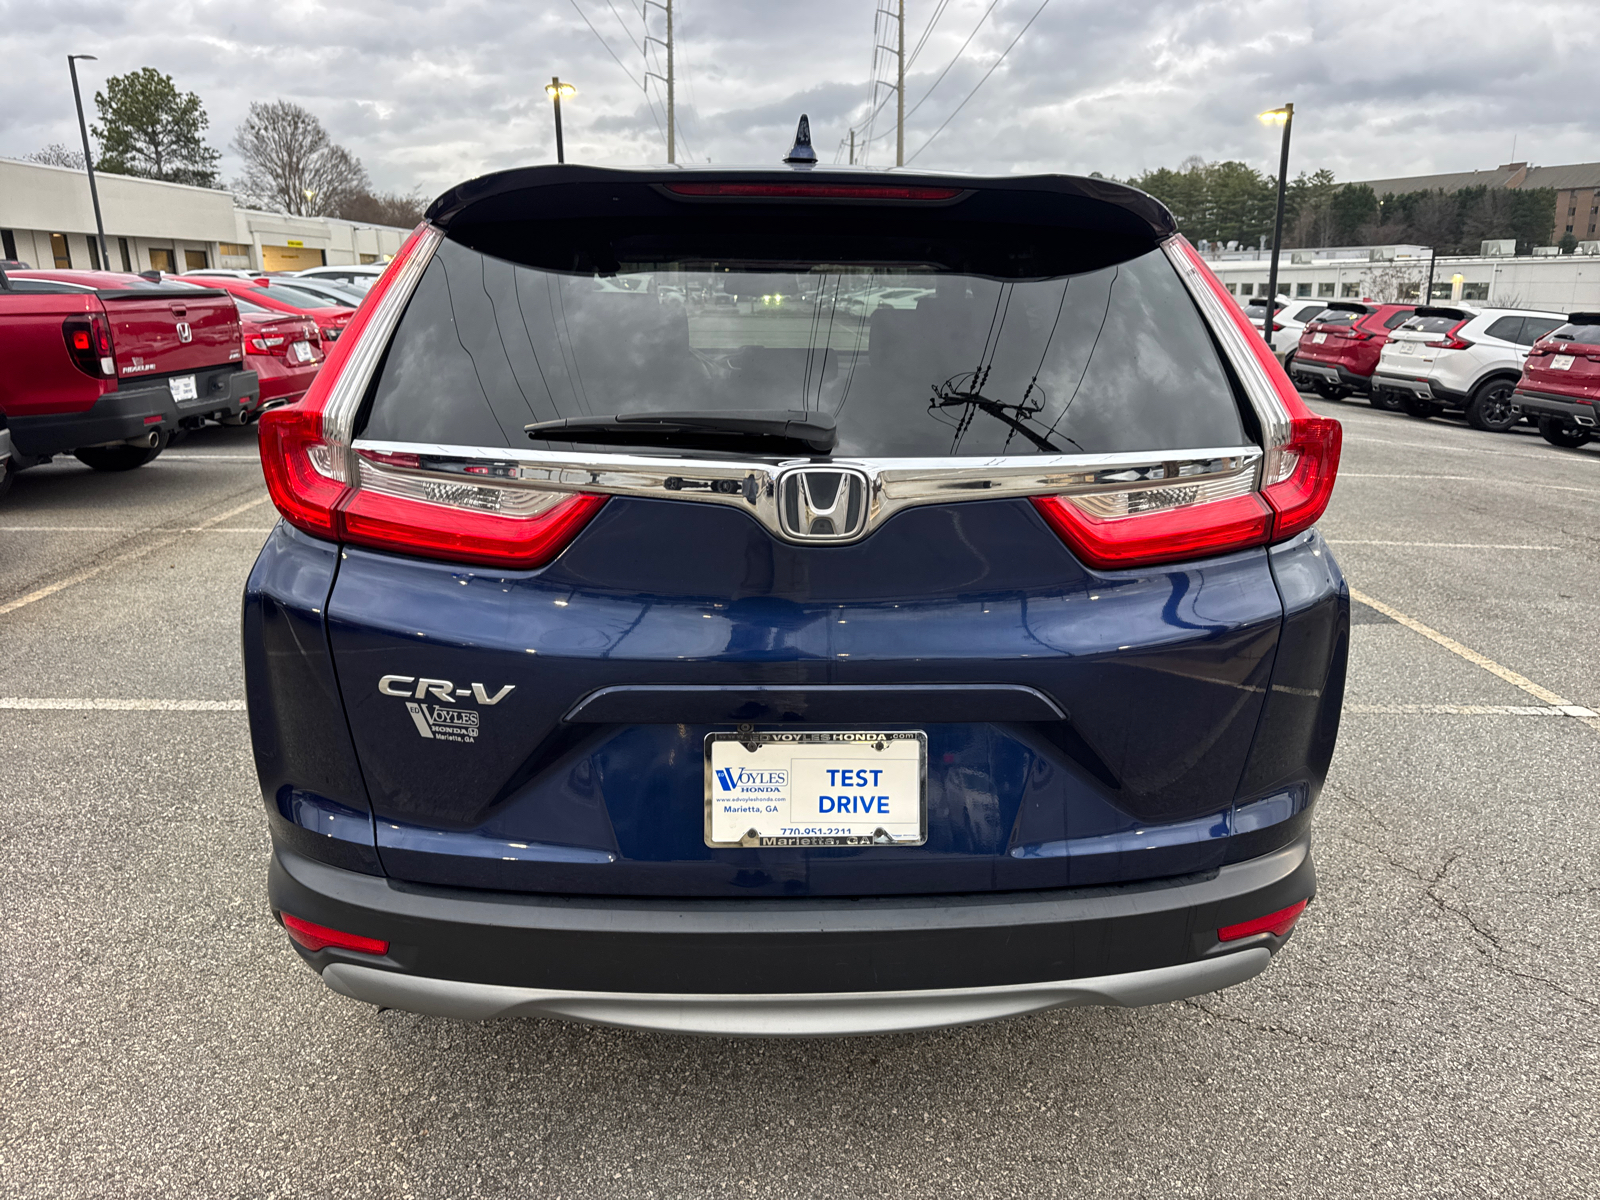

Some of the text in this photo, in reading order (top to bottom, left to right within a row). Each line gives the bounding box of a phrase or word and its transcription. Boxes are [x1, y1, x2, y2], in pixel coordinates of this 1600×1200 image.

[378, 674, 516, 705] CR-V
[410, 706, 420, 714] ED
[421, 703, 478, 725] VOYLES
[431, 726, 468, 735] HONDA
[435, 733, 464, 743] Marietta,
[833, 733, 887, 741] HONDA
[724, 767, 785, 789] VOYLES
[826, 769, 884, 787] TEST
[723, 805, 779, 814] Marietta, GA
[818, 795, 890, 814] DRIVE
[762, 836, 871, 846] Marietta, GA
